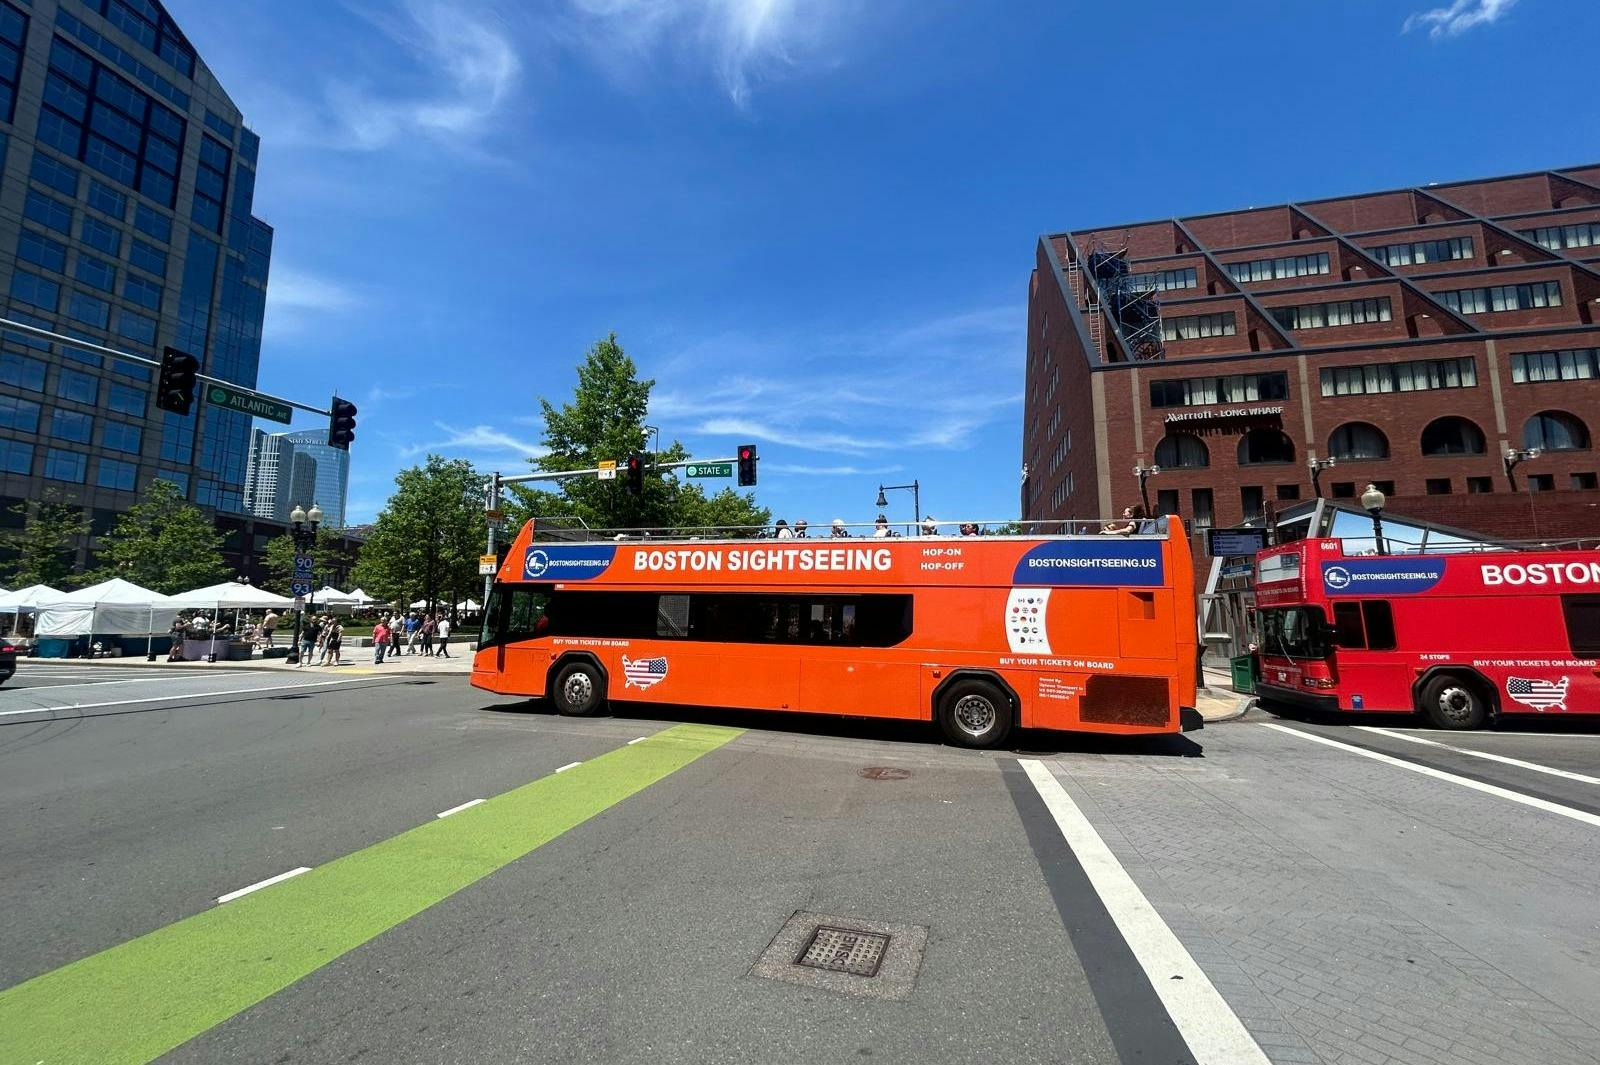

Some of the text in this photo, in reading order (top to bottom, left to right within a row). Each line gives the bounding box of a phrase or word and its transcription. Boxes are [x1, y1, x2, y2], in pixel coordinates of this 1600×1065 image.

[230, 395, 287, 419] ATLANTIC AVE
[1220, 409, 1246, 417] LONG
[1248, 406, 1284, 415] WHARF
[698, 467, 720, 475] STATE
[922, 548, 961, 556] HOP-ON
[296, 557, 312, 568] 90
[548, 559, 610, 567] BOSTONSIGHTSEEING.US
[634, 549, 892, 571] BOSTON SIGHTSEEING
[1029, 558, 1157, 568] BOSTONSIGHTSEEING.US
[920, 562, 965, 570] HOP-OFF
[1352, 572, 1438, 581] BOSTONSIGHTSEEING.US
[293, 583, 309, 594] 93
[999, 657, 1015, 665] BUY
[1017, 658, 1038, 666] YOUR
[1040, 658, 1072, 667] TICKETS
[1086, 661, 1114, 669] BOARD
